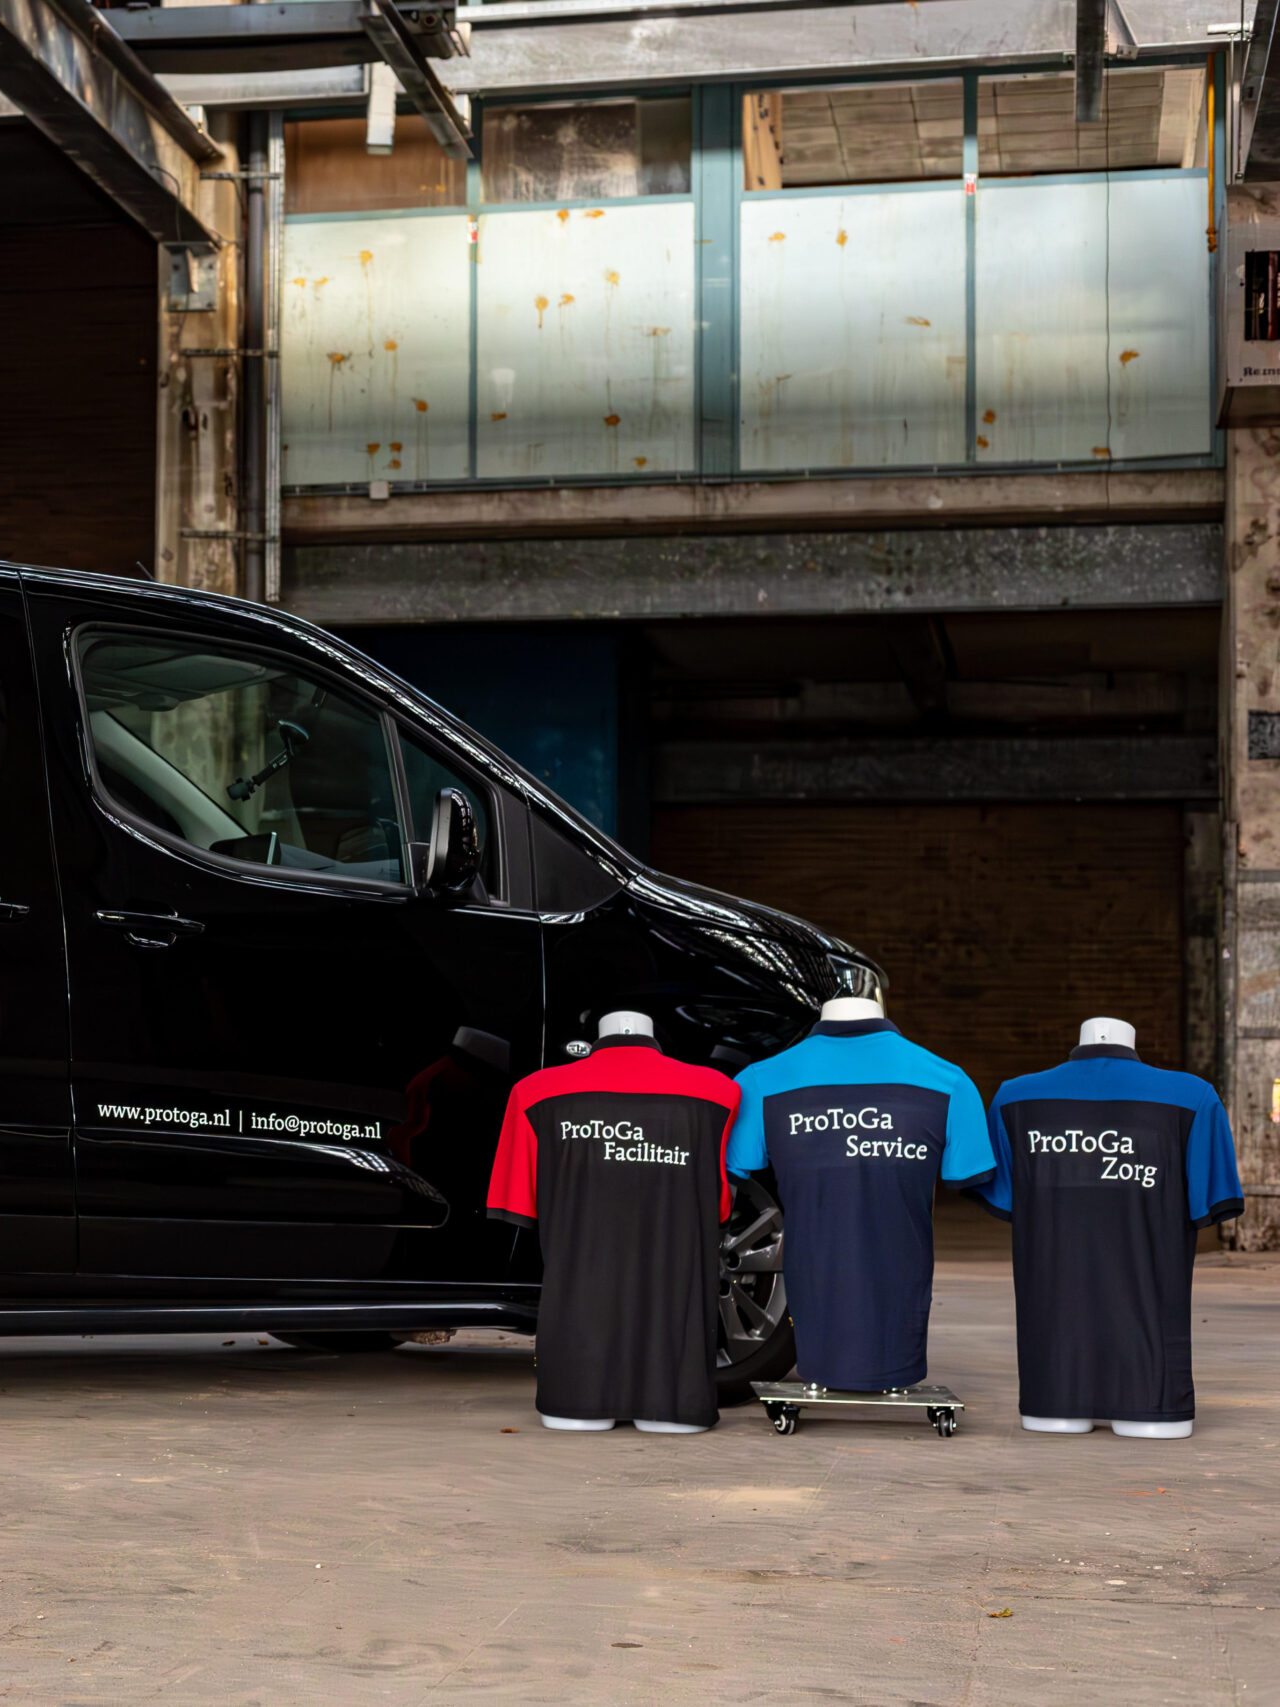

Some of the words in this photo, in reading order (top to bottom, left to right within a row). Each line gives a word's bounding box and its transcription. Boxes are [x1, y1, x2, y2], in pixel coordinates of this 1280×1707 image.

[97, 1103, 231, 1129] www.protoga.nl
[251, 1112, 382, 1141] info@protoga.nl
[560, 1119, 645, 1142] ProToGa
[788, 1106, 894, 1136] ProToGa
[603, 1141, 690, 1166] Facilitair
[845, 1134, 928, 1161] Service
[1027, 1129, 1135, 1155] ProToGa
[1100, 1156, 1158, 1189] Zorg
